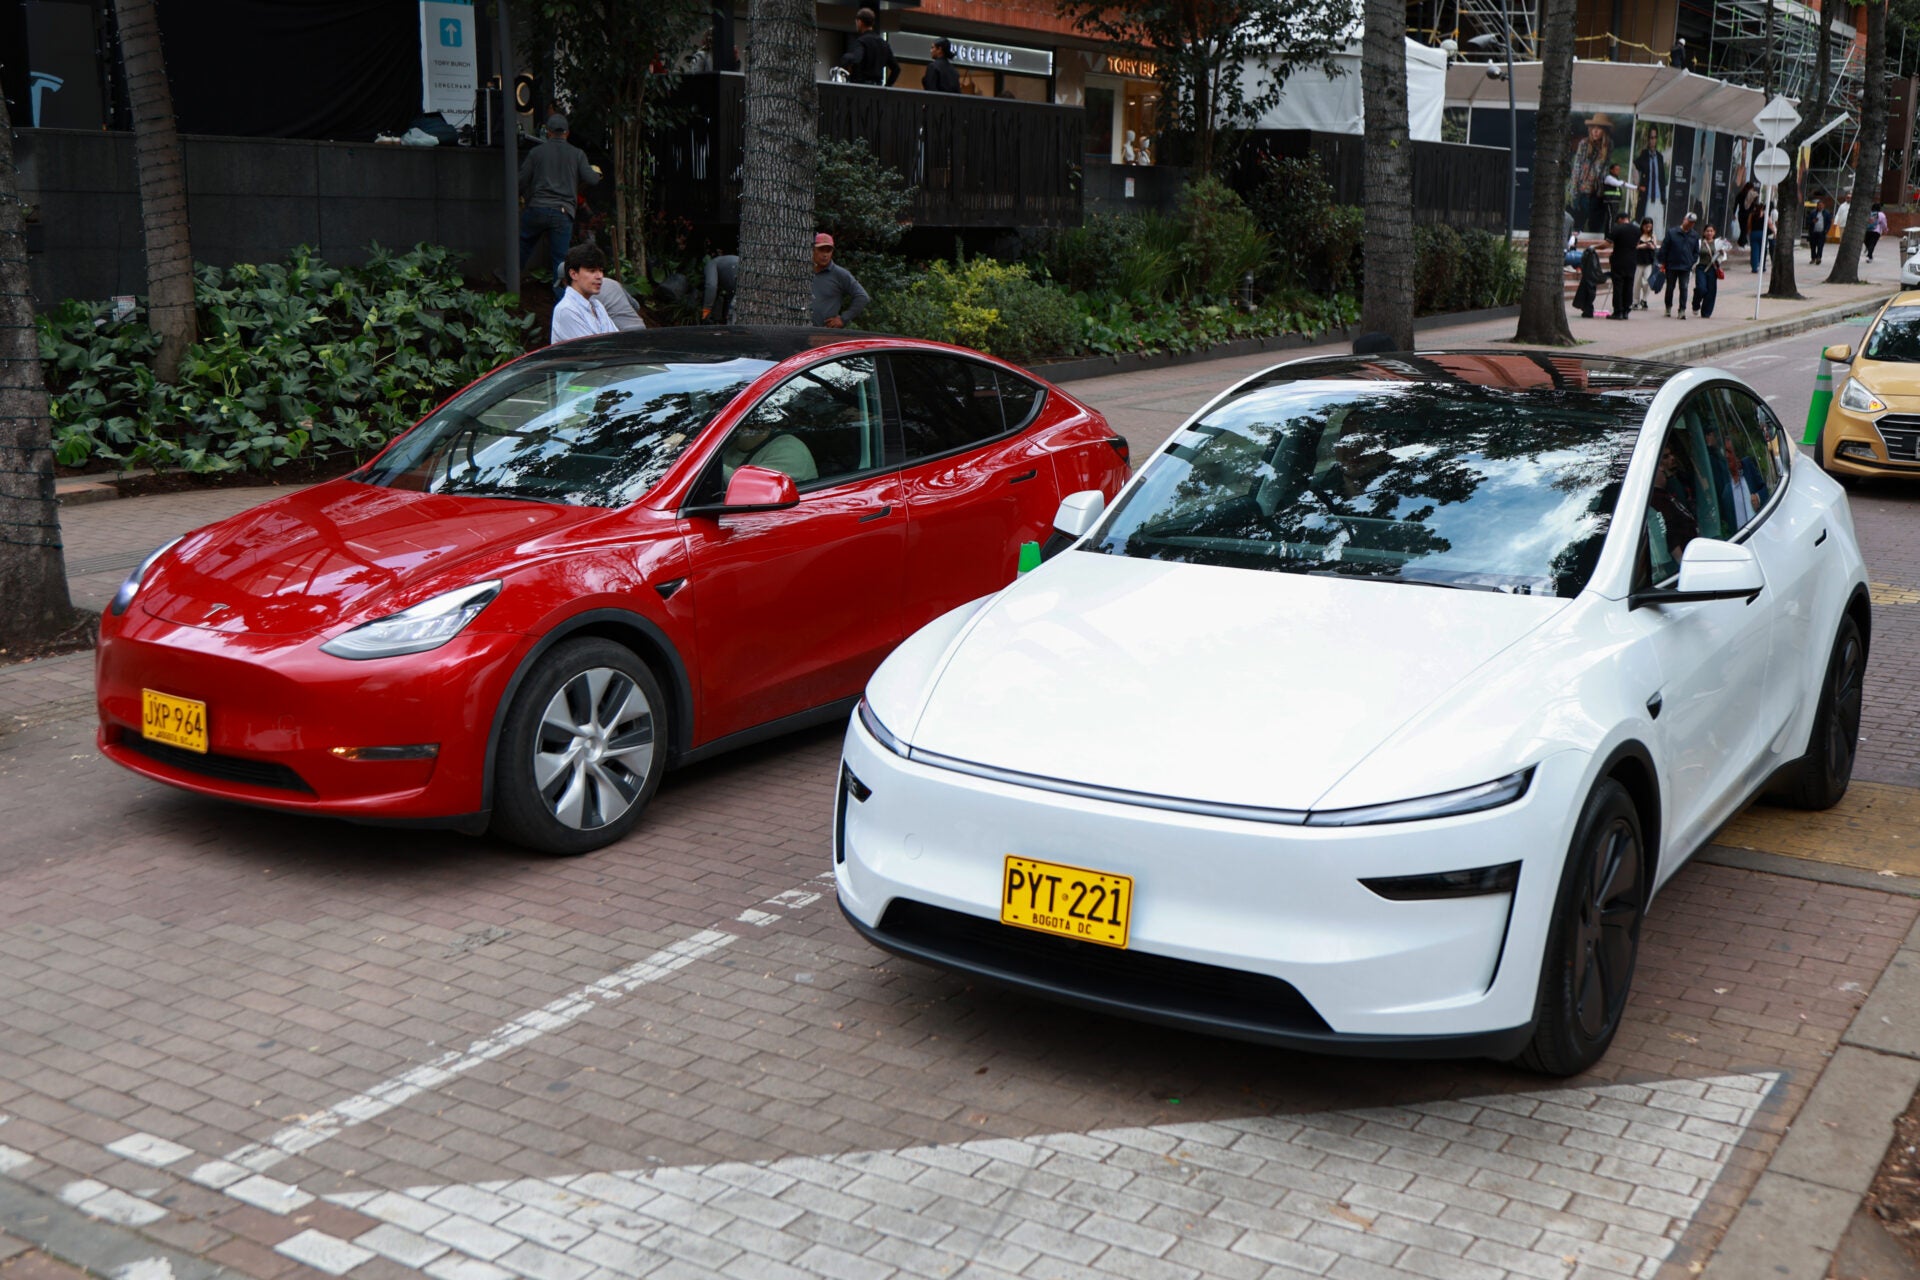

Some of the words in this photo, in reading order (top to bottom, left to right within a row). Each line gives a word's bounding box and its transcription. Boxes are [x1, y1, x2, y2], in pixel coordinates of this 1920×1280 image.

[949, 43, 1013, 65] NGCHAMP
[1107, 57, 1138, 75] TORY
[145, 700, 170, 729] JXP
[174, 707, 203, 738] 964
[1006, 868, 1062, 913] PYT
[1068, 881, 1121, 927] 221
[1032, 913, 1071, 930] BOGOTA
